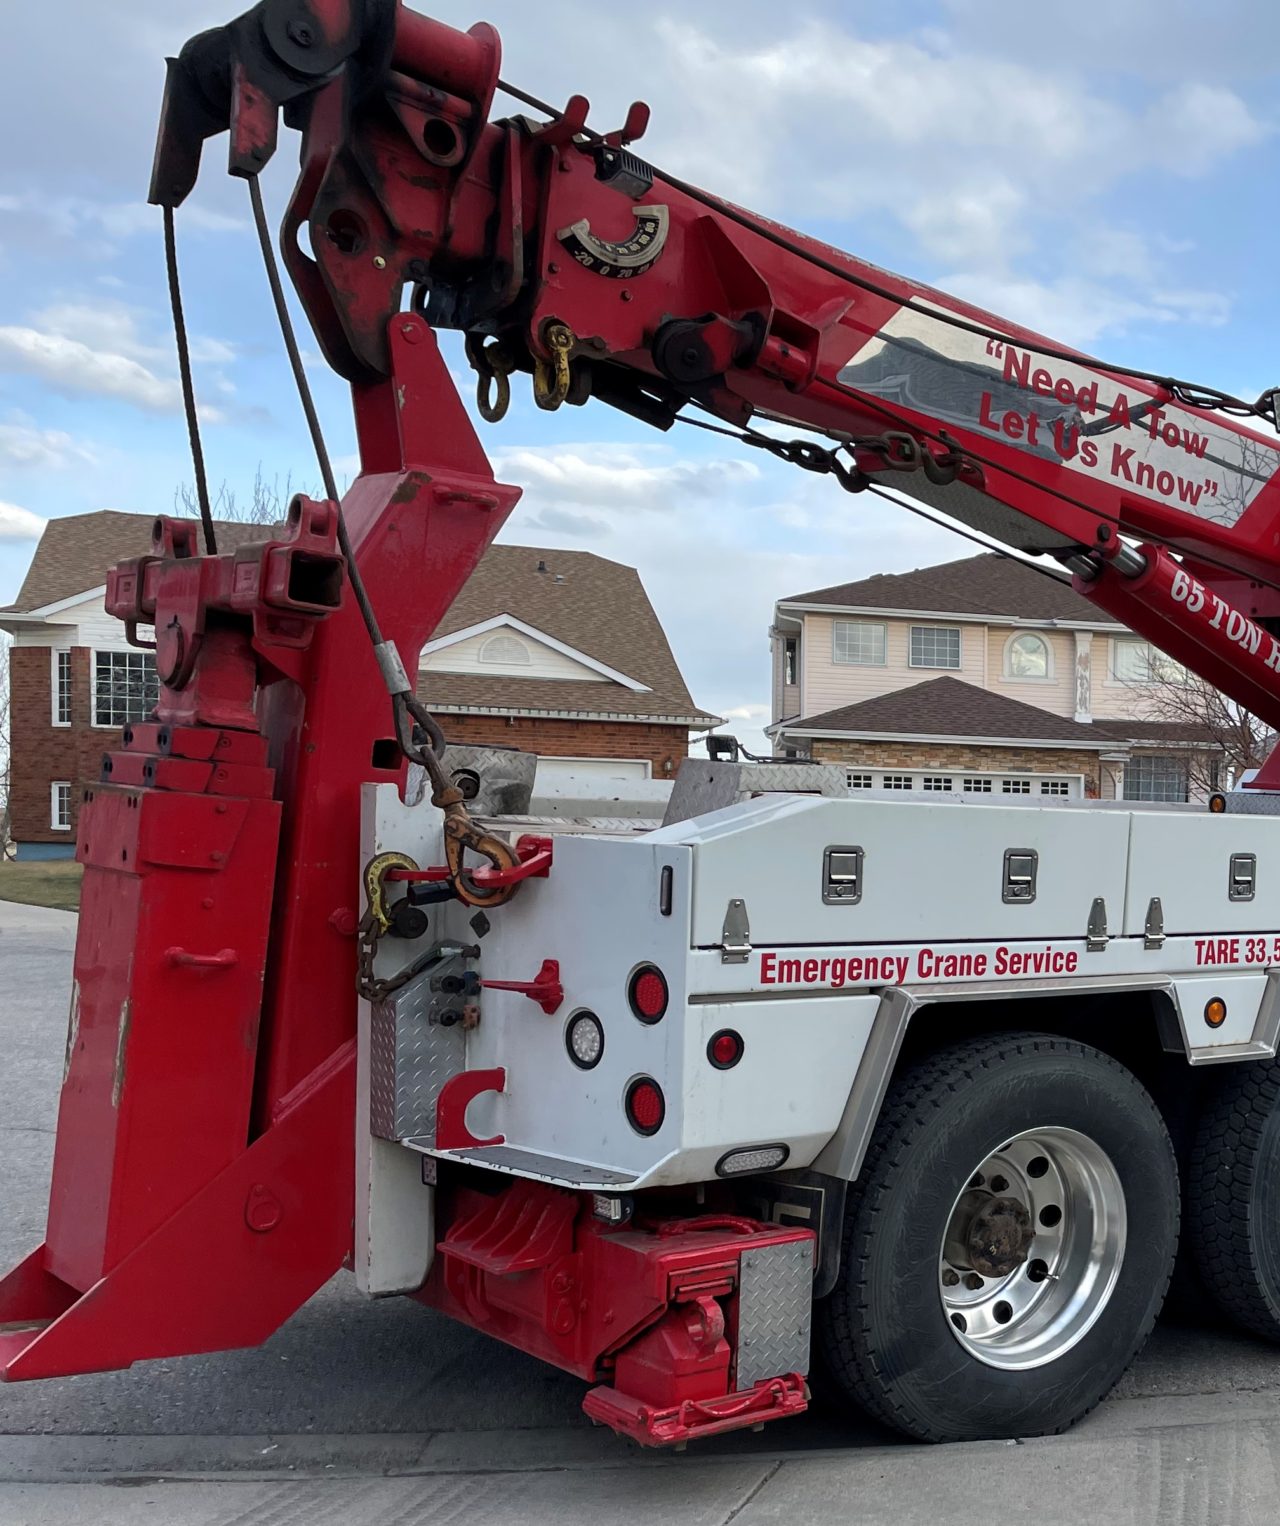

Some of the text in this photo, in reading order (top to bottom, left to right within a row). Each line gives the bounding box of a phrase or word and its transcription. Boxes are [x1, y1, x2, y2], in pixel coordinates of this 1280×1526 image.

[979, 391, 1041, 446] Let
[1053, 418, 1099, 467] Us
[1109, 393, 1131, 430] A
[1145, 405, 1209, 459] Tow
[1170, 569, 1206, 613] 65
[1208, 594, 1264, 656] TON
[760, 946, 1078, 987] Emergency Crane Service
[1195, 938, 1240, 965] TARE
